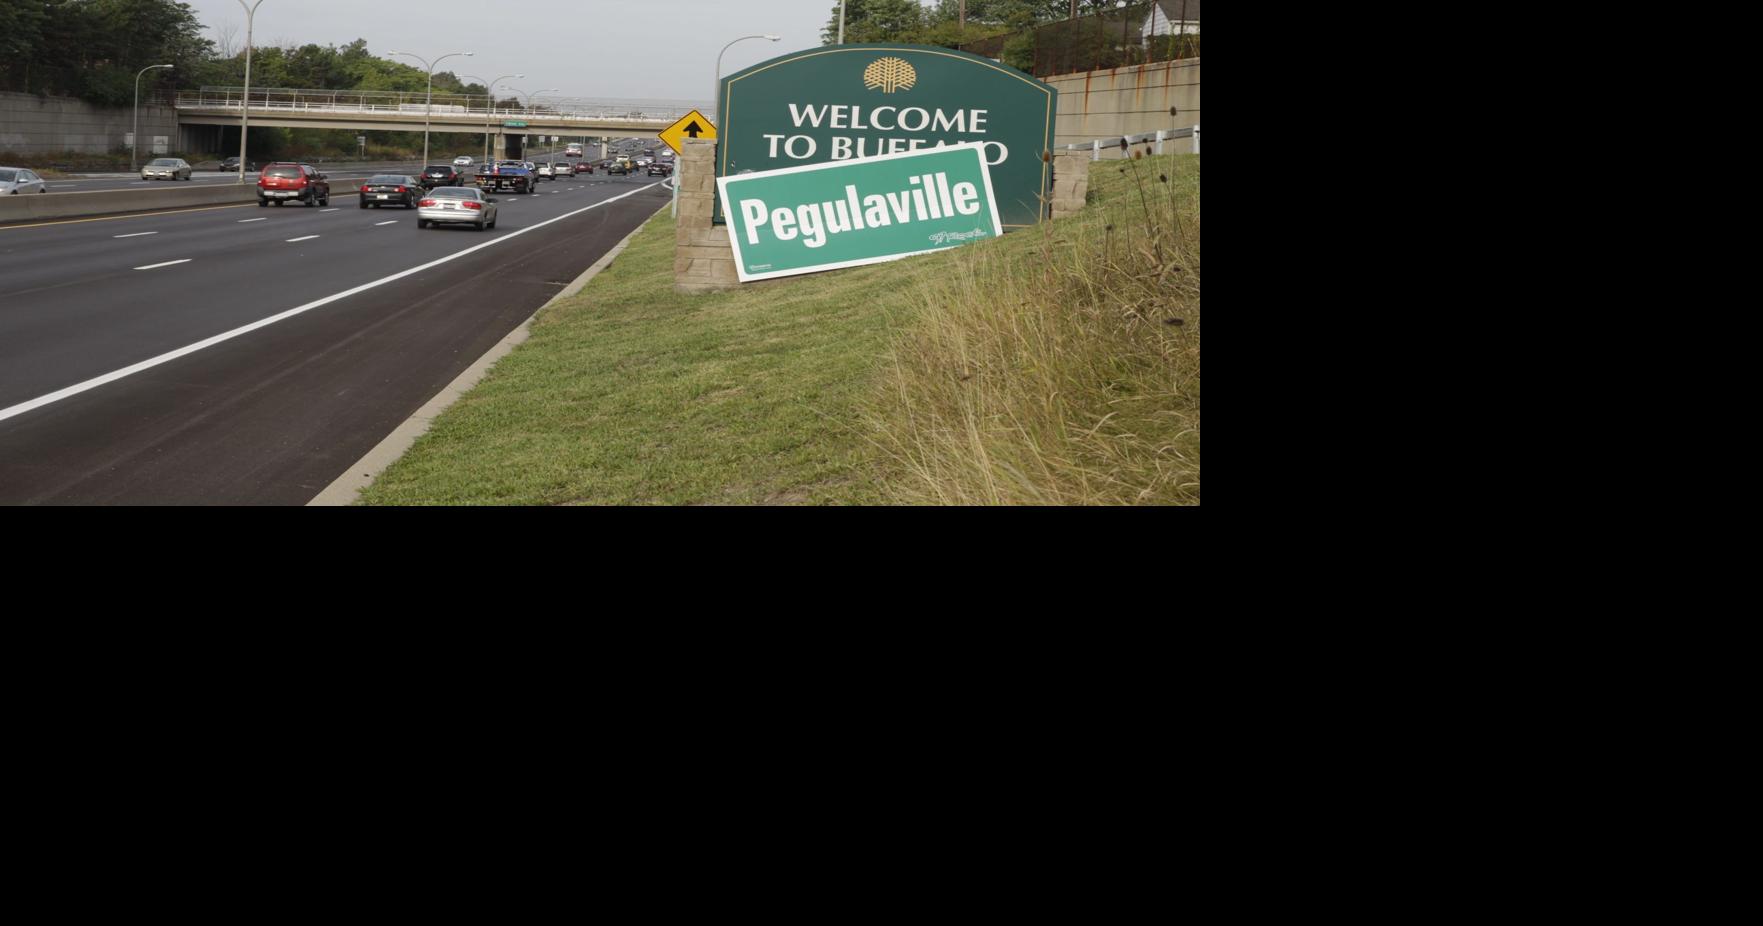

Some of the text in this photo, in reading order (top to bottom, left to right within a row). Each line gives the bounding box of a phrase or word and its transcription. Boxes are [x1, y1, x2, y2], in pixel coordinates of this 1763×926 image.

[788, 103, 988, 133] WELCOME
[763, 134, 1009, 166] TO BUFO
[740, 172, 980, 248] Pegulaville
